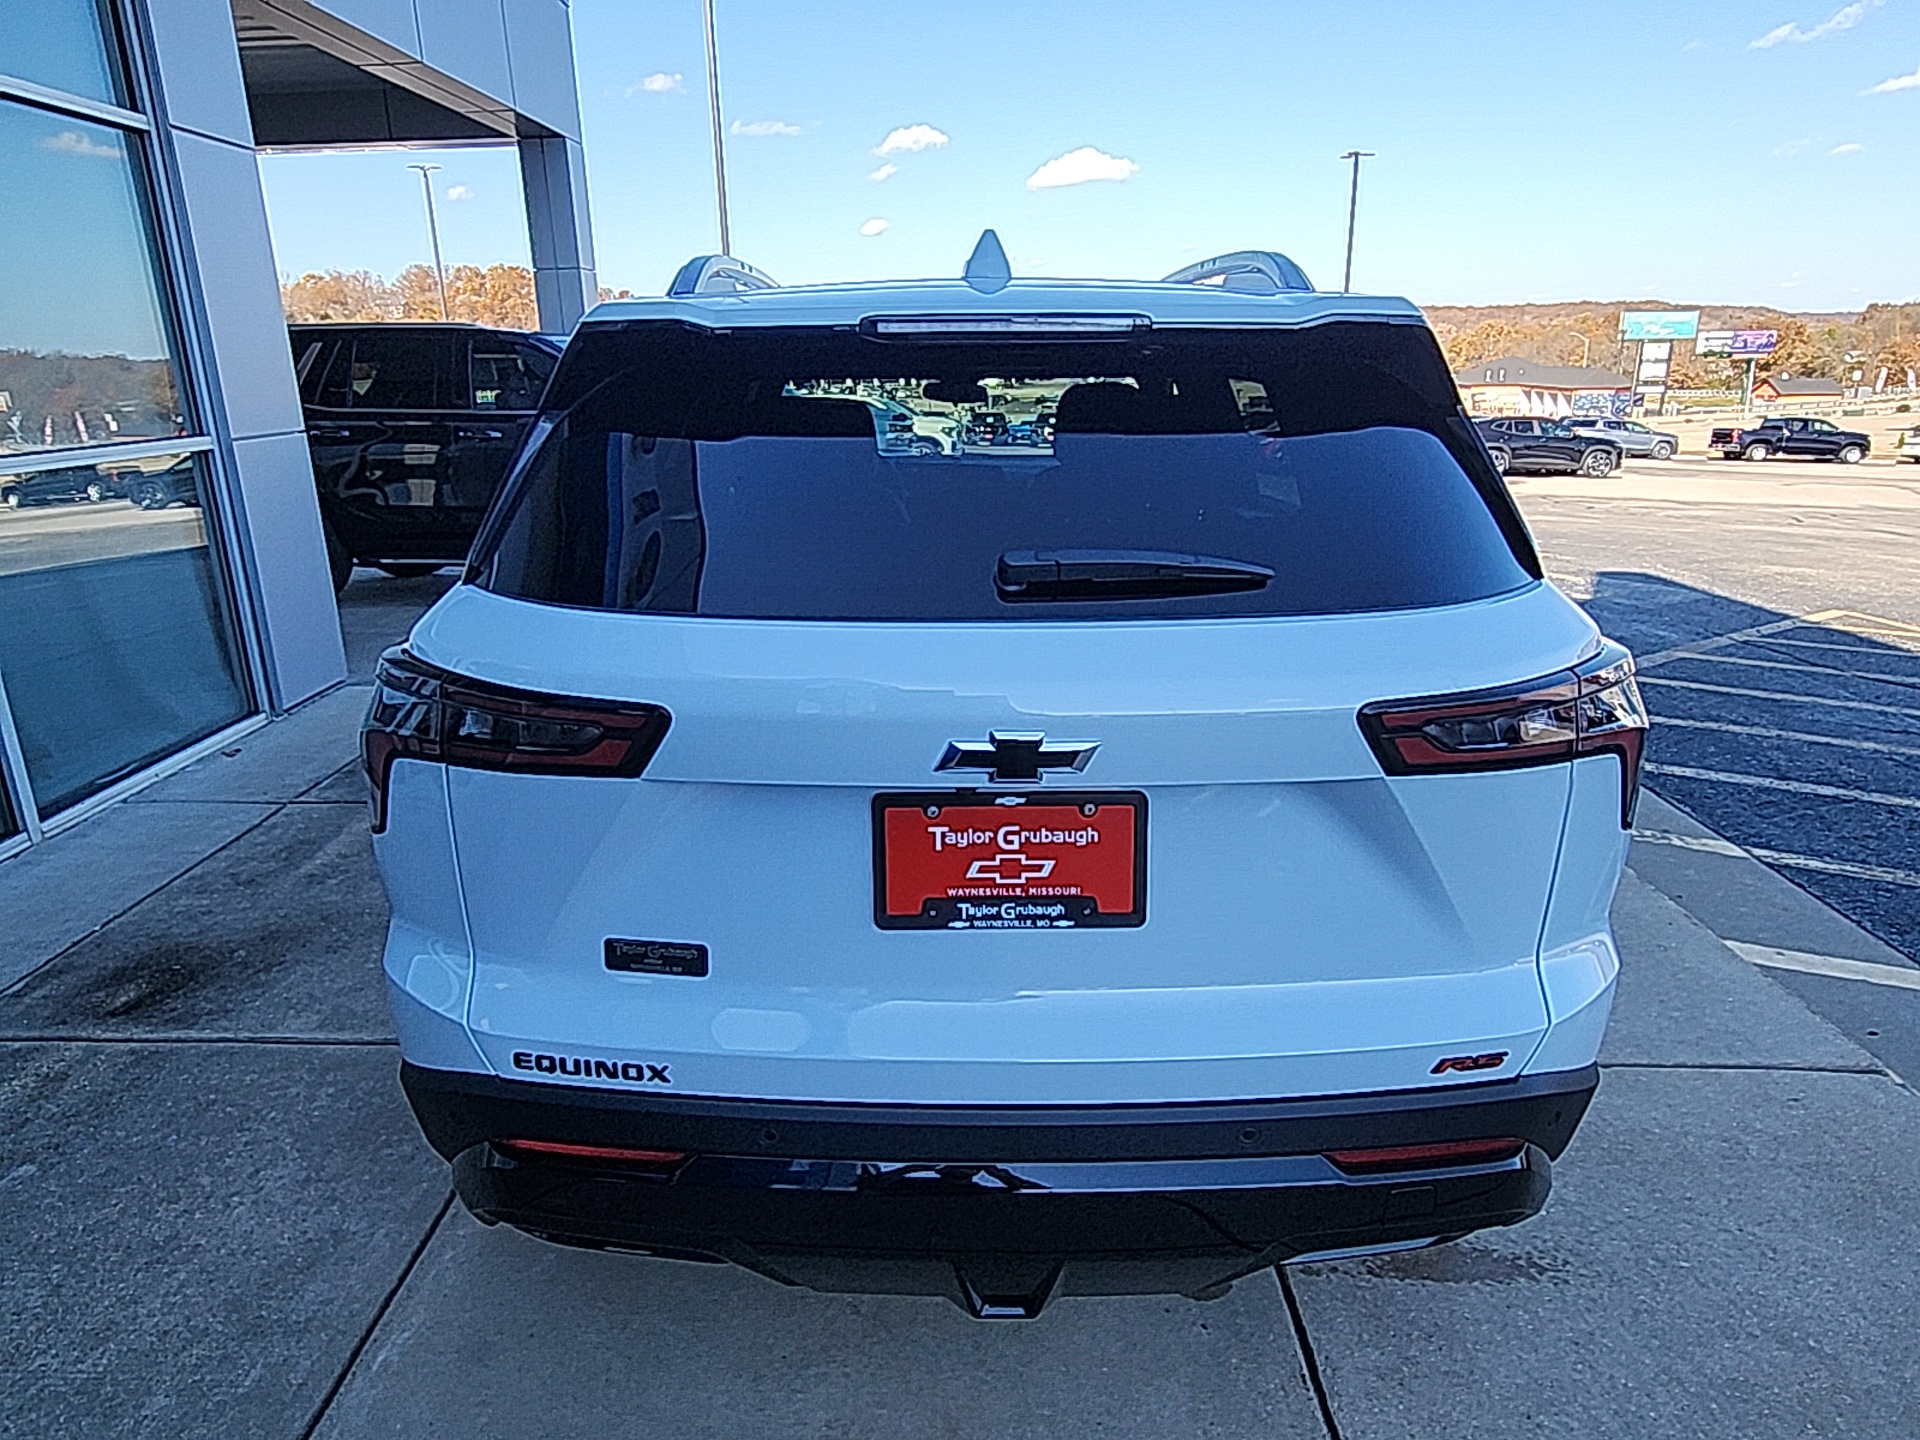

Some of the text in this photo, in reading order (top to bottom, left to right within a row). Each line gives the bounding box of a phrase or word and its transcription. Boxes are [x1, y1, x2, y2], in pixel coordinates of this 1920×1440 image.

[928, 826, 1099, 851] Taylor Grubaugh
[947, 887, 1081, 897] WAYNESVILLE, MISSOURI
[957, 902, 1065, 919] Taylor Grubaugh
[1036, 919, 1050, 927] MO
[513, 1051, 672, 1084] EQUINOX
[1430, 1051, 1510, 1075] RS
